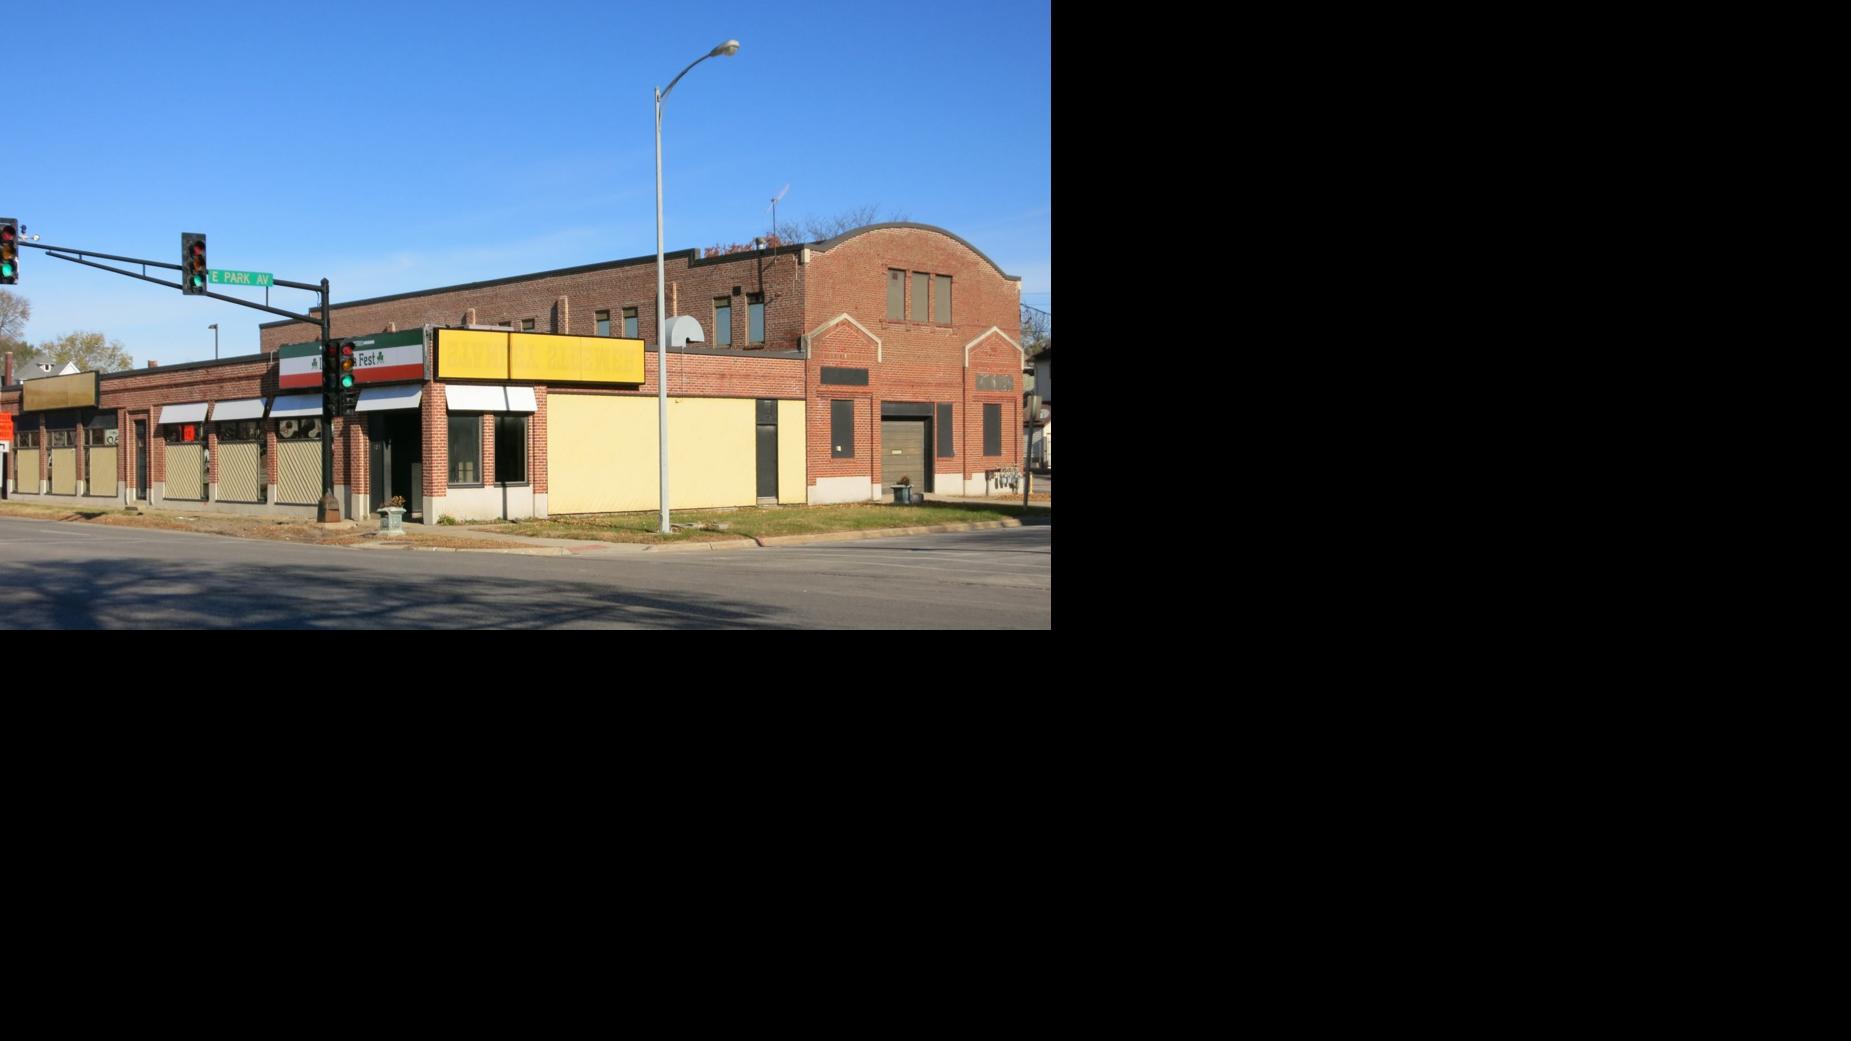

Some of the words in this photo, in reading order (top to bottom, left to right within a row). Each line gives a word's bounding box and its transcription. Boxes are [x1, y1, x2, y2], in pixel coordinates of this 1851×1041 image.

[211, 271, 218, 282] E
[224, 272, 250, 284] PARK
[256, 274, 269, 285] AV
[358, 351, 375, 367] Fest
